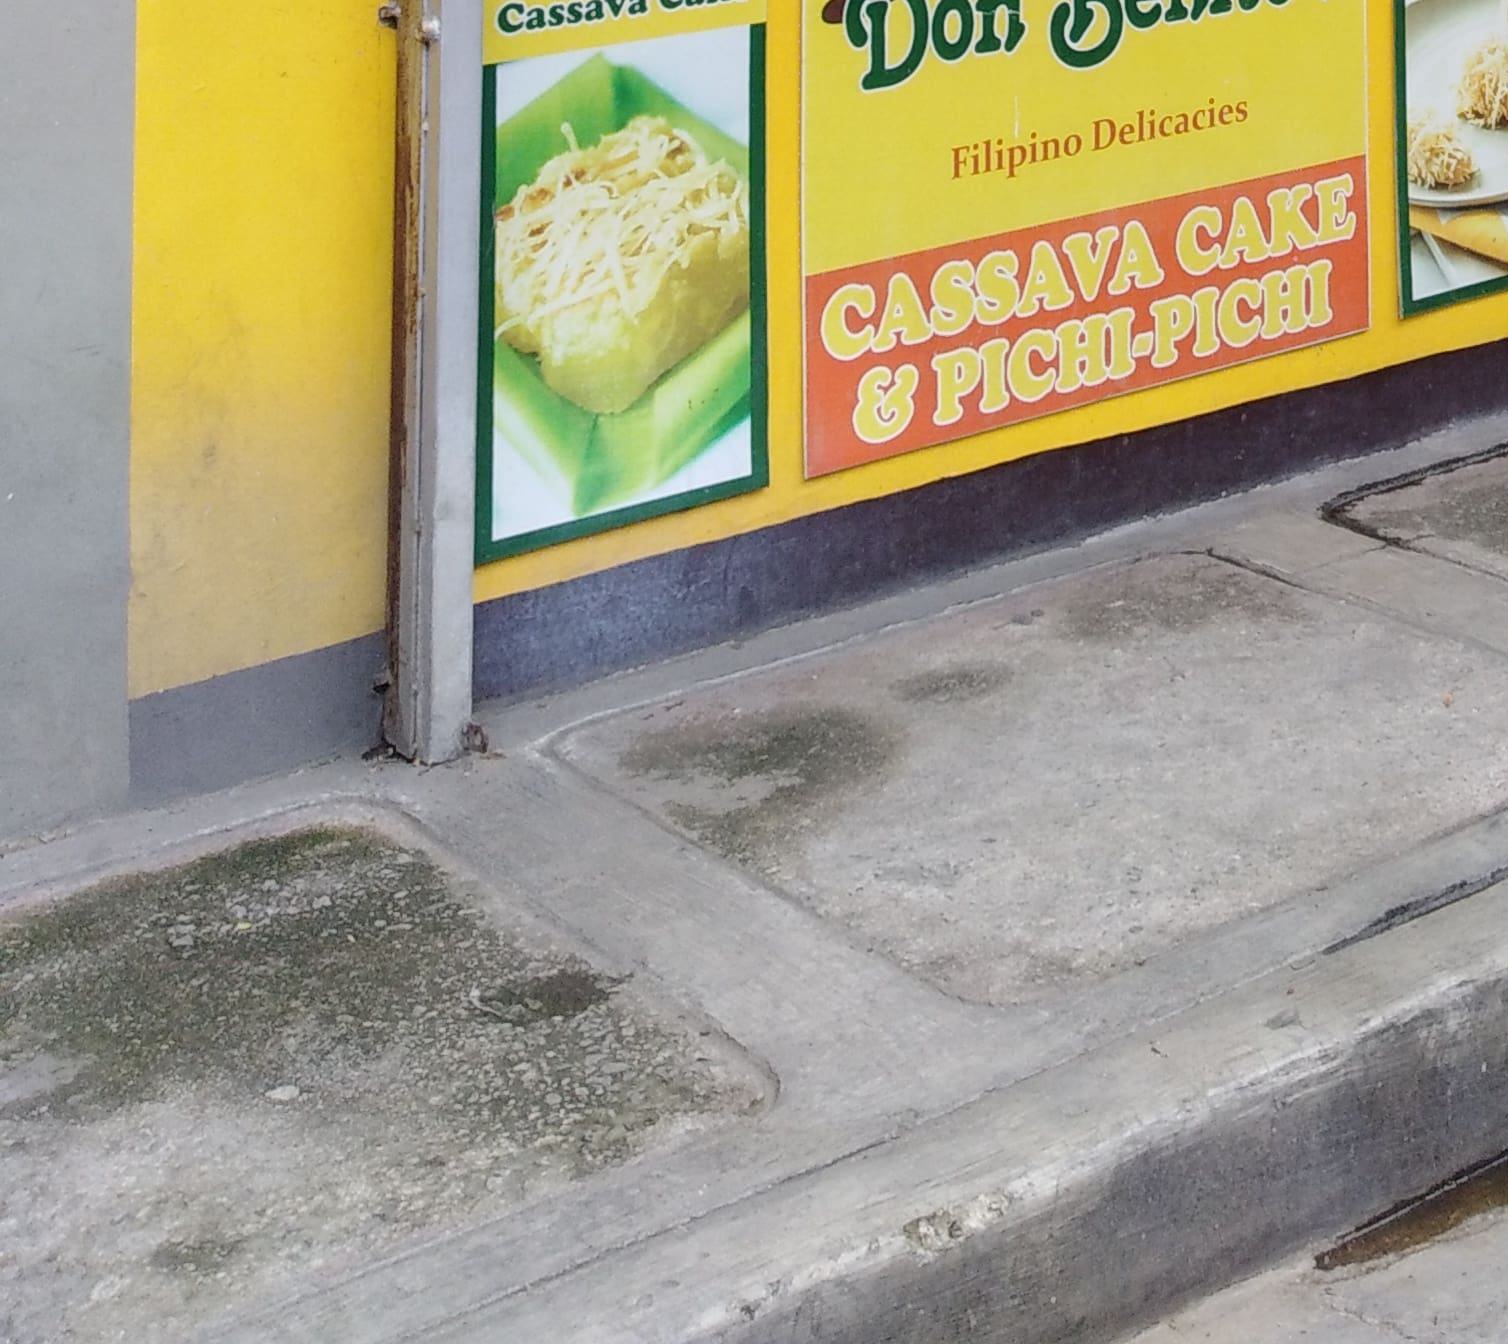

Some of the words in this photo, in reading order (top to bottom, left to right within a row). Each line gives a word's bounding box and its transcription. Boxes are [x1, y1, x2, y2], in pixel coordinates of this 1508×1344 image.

[950, 128, 1082, 180] Filipino
[1092, 96, 1249, 153] Delicacies
[820, 221, 1164, 361] CASSAVA
[1176, 173, 1356, 276] CAKE
[851, 364, 919, 443] &
[932, 259, 1333, 426] PICHI-PICHI
